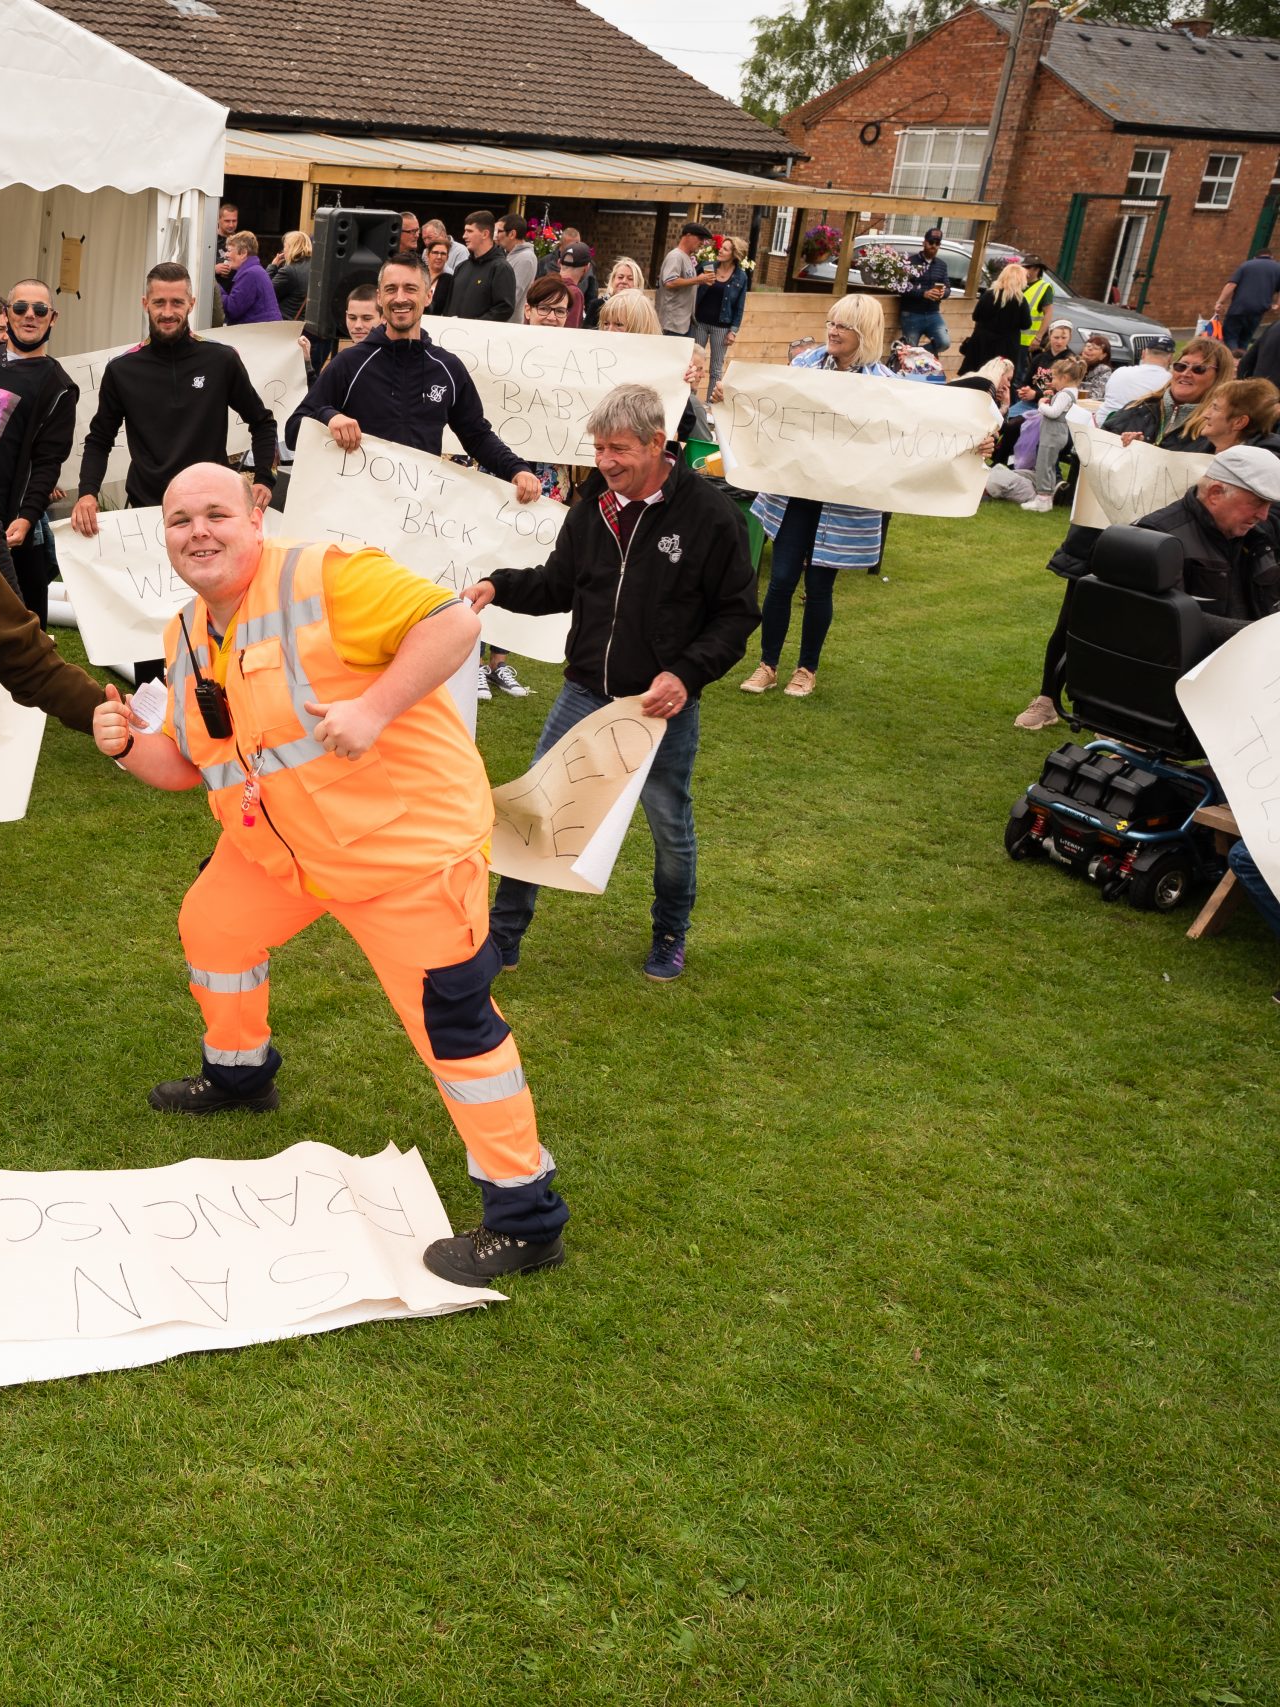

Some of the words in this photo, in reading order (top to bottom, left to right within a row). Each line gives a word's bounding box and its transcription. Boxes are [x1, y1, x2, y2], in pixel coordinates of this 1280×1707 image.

[438, 327, 620, 385] SUGAR
[492, 379, 597, 420] BABY
[729, 392, 871, 447] PRETTY
[887, 419, 977, 458] WOMA
[498, 416, 598, 458] OVE
[324, 438, 456, 496] DON'T
[495, 500, 557, 547] LOO
[394, 495, 478, 546] BACK
[73, 1250, 350, 1333] SAN
